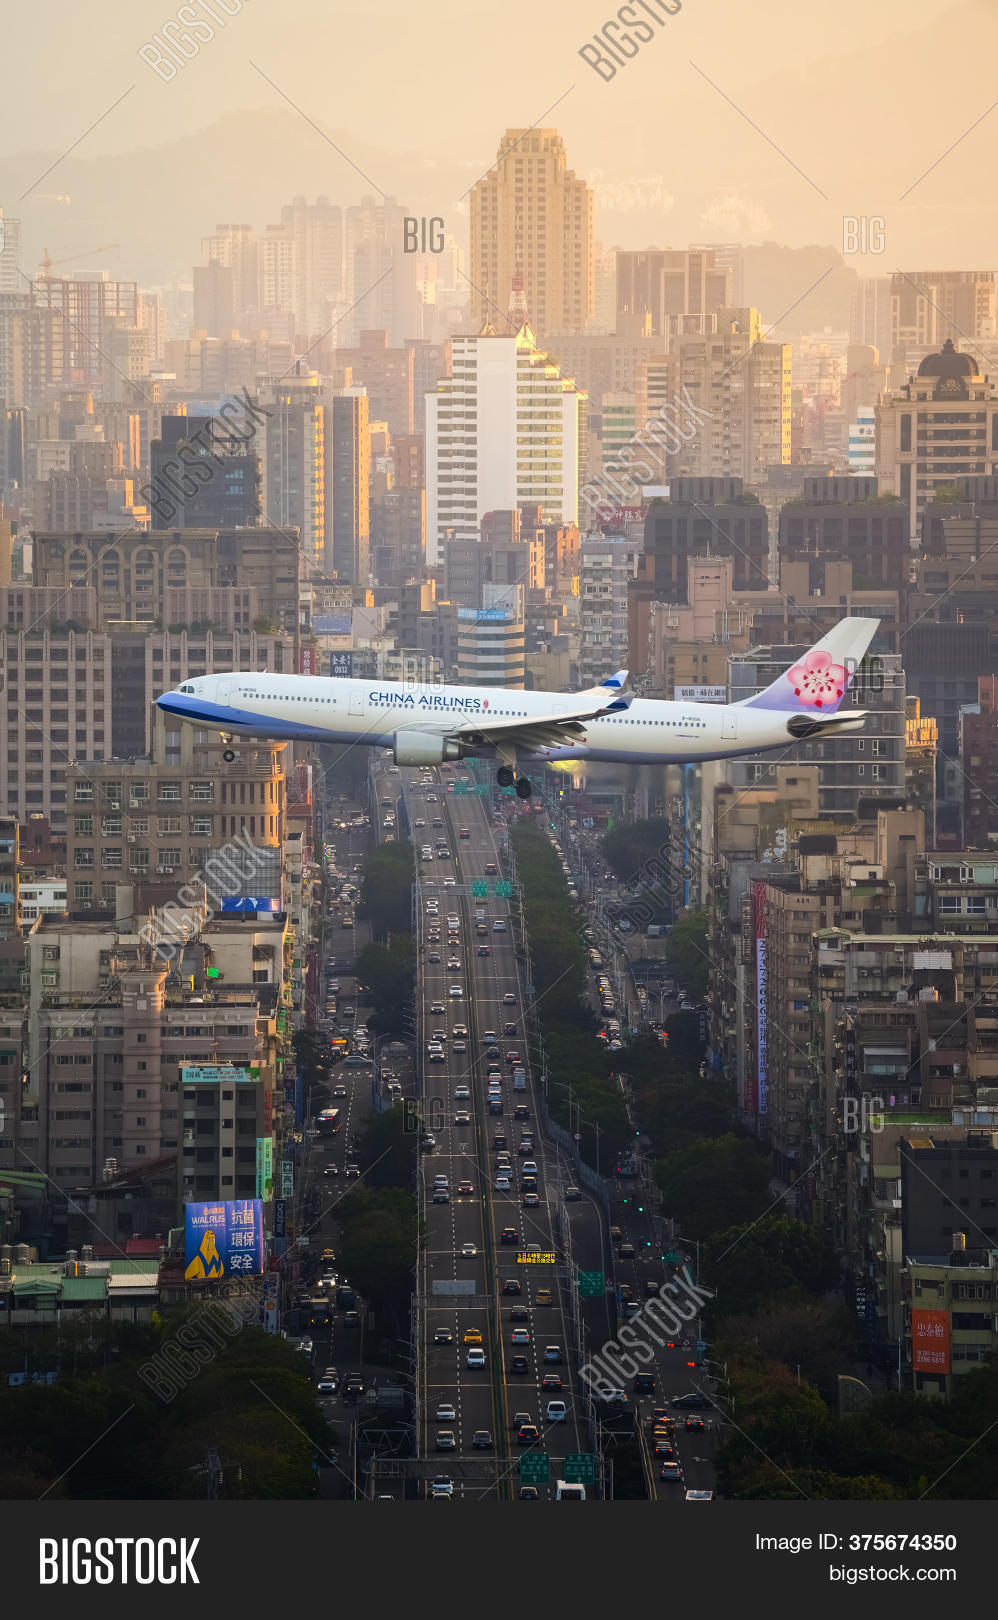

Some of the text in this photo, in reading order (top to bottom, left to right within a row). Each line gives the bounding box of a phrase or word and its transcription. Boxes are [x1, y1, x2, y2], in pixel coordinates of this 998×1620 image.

[369, 691, 482, 709] CHINA AIRLINES
[191, 1214, 226, 1225] WALRUS
[231, 1209, 254, 1225] 抗菌
[231, 1231, 254, 1247] 環保
[230, 1253, 254, 1270] 安全
